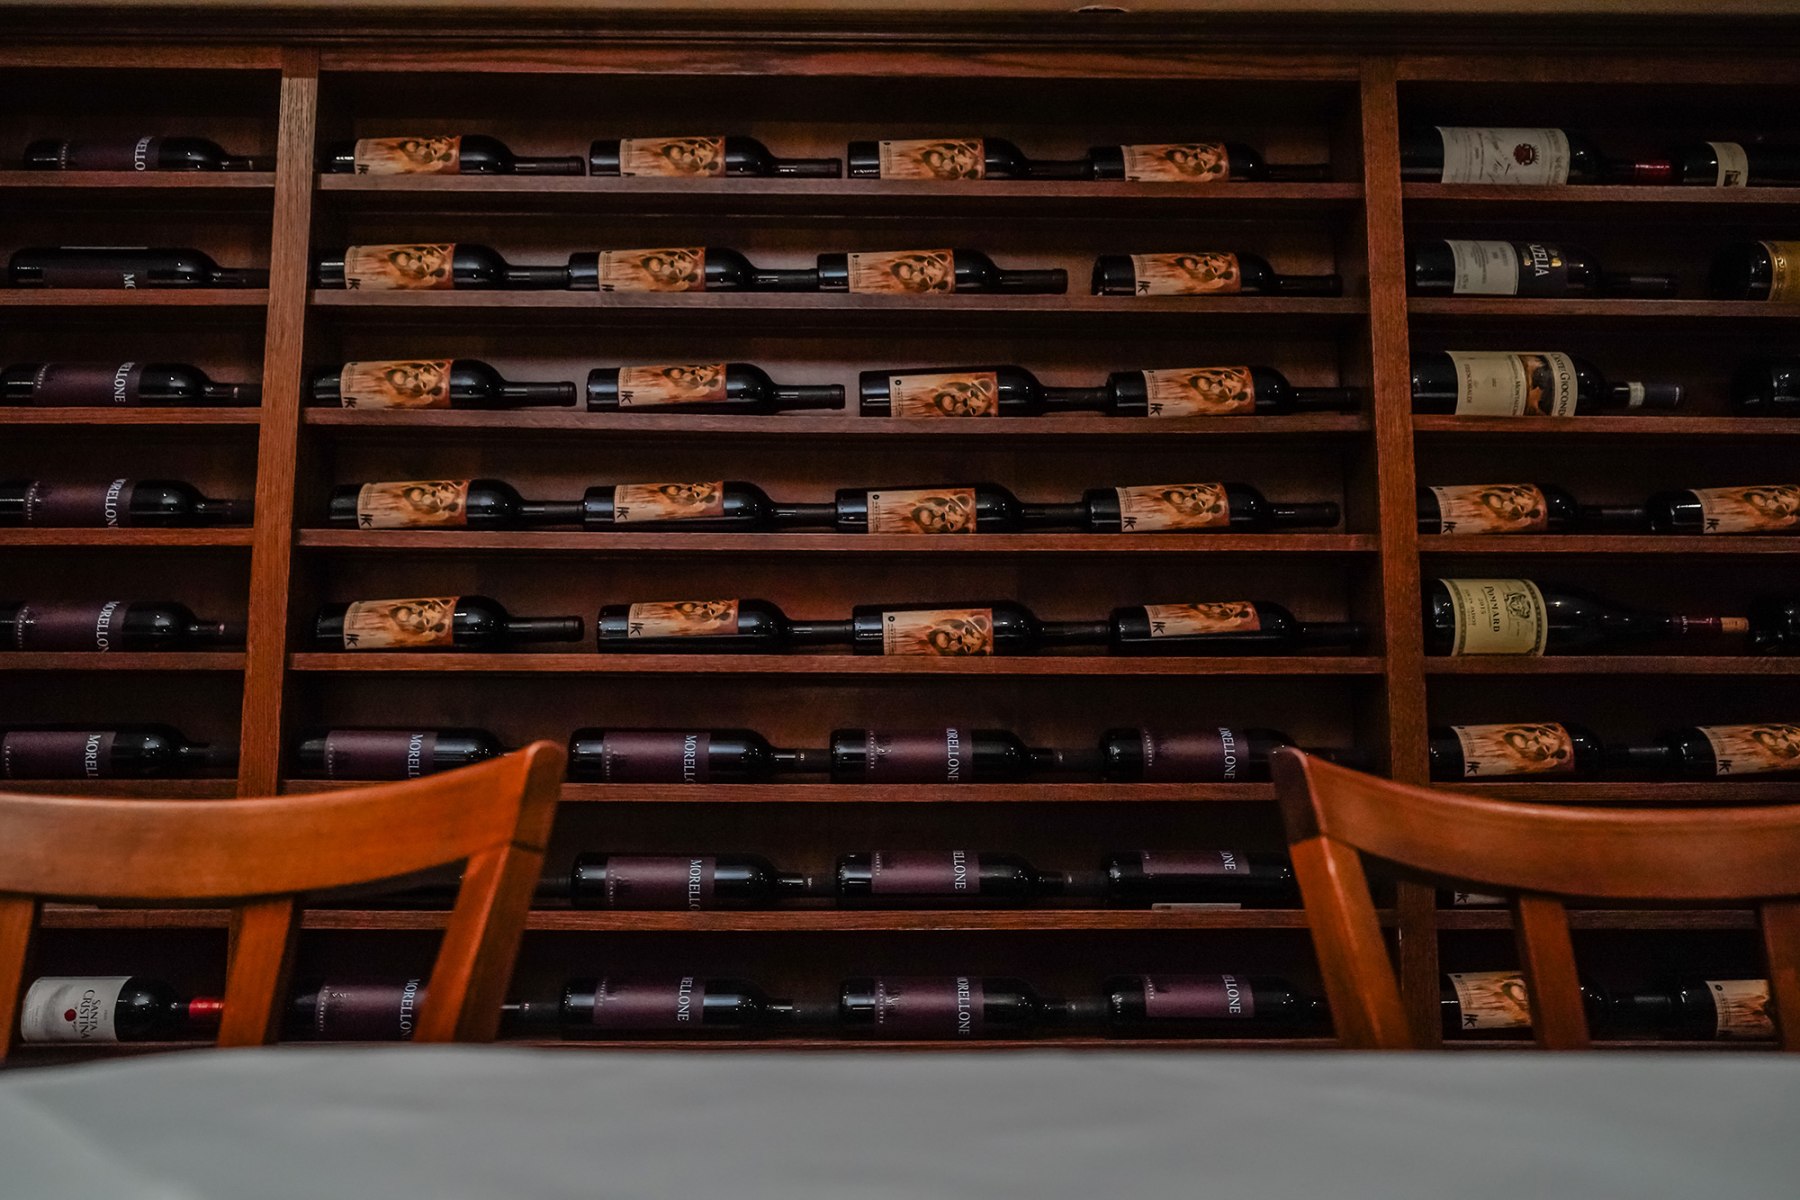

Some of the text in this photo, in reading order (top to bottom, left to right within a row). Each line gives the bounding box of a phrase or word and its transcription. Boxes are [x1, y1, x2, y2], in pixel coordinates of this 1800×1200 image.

[1484, 586, 1501, 633] POMMARD
[79, 989, 96, 1039] CRISTINA
[90, 999, 101, 1031] SANTA
